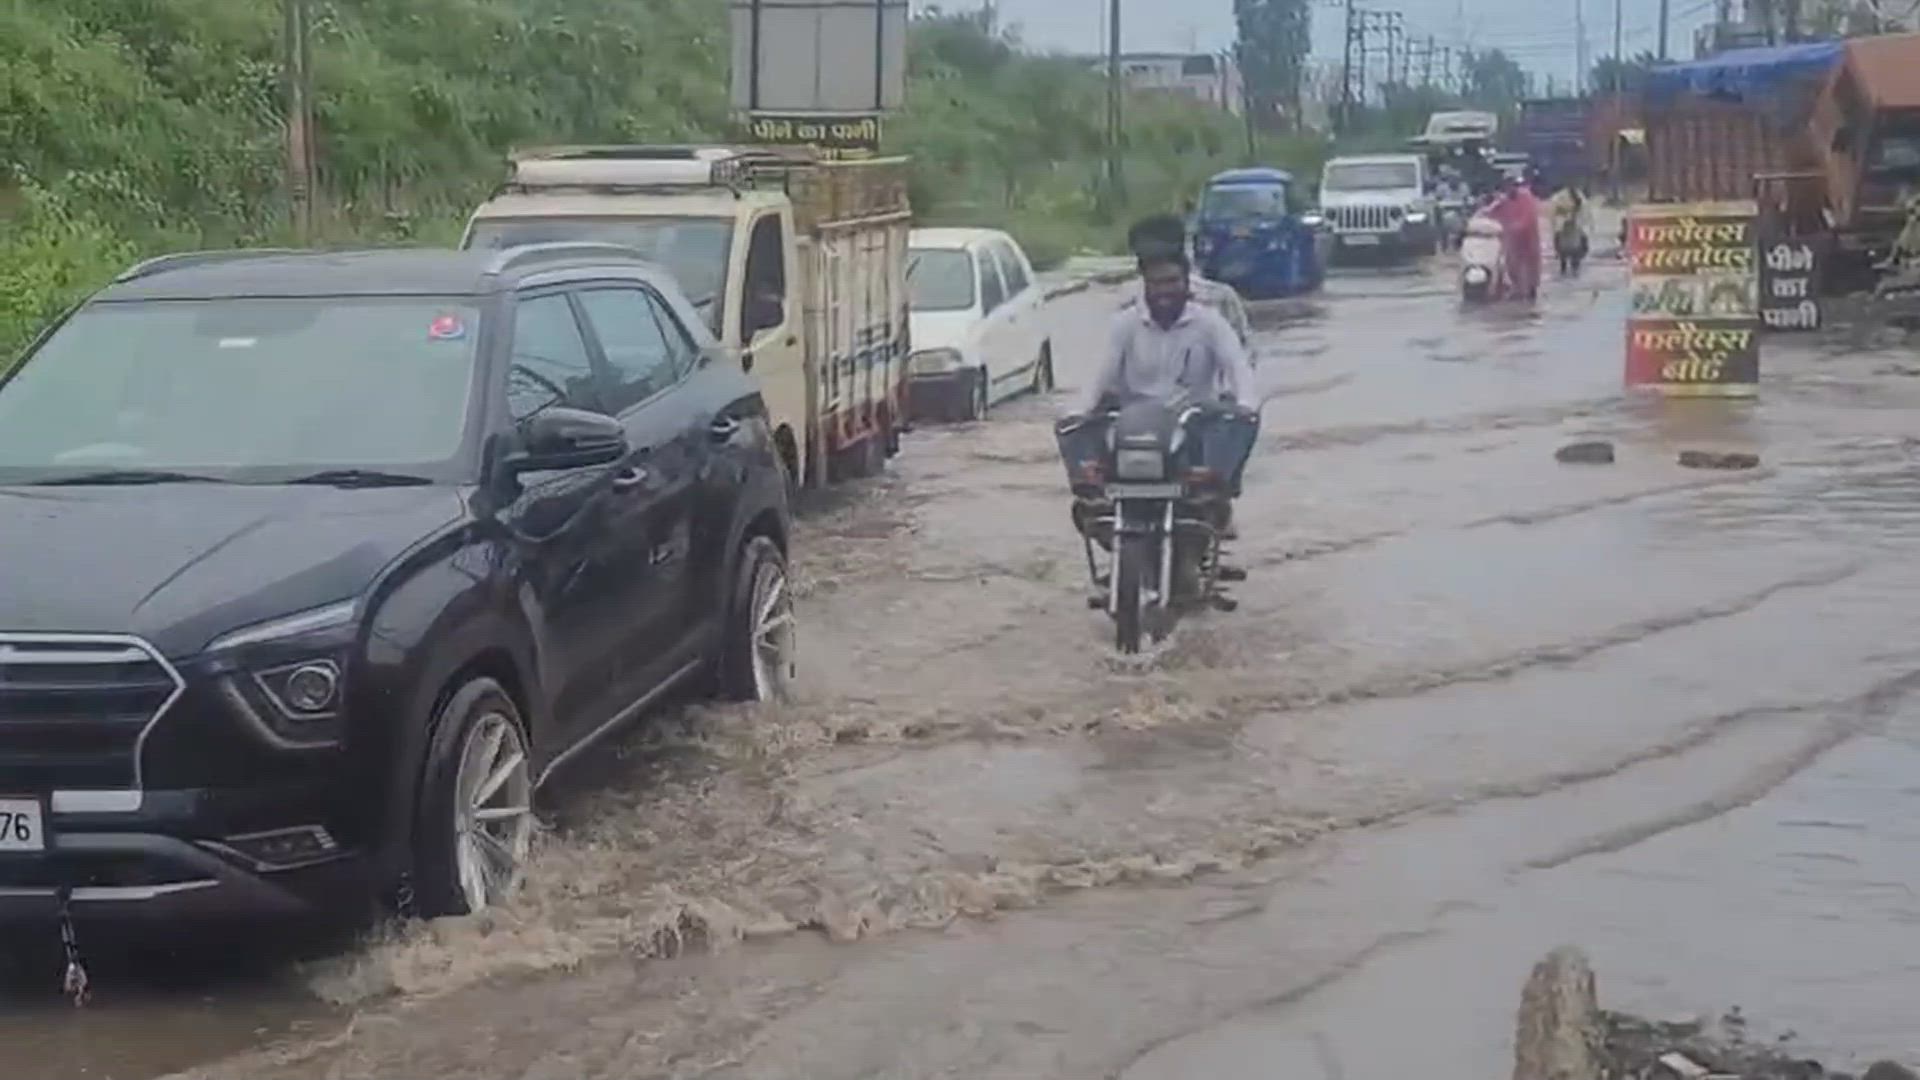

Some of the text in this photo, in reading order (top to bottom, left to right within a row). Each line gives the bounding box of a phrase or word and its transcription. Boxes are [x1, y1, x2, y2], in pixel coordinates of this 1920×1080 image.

[798, 124, 825, 139] का
[1766, 245, 1813, 271] पीने
[1773, 278, 1807, 297] का
[1762, 301, 1817, 328] पानी
